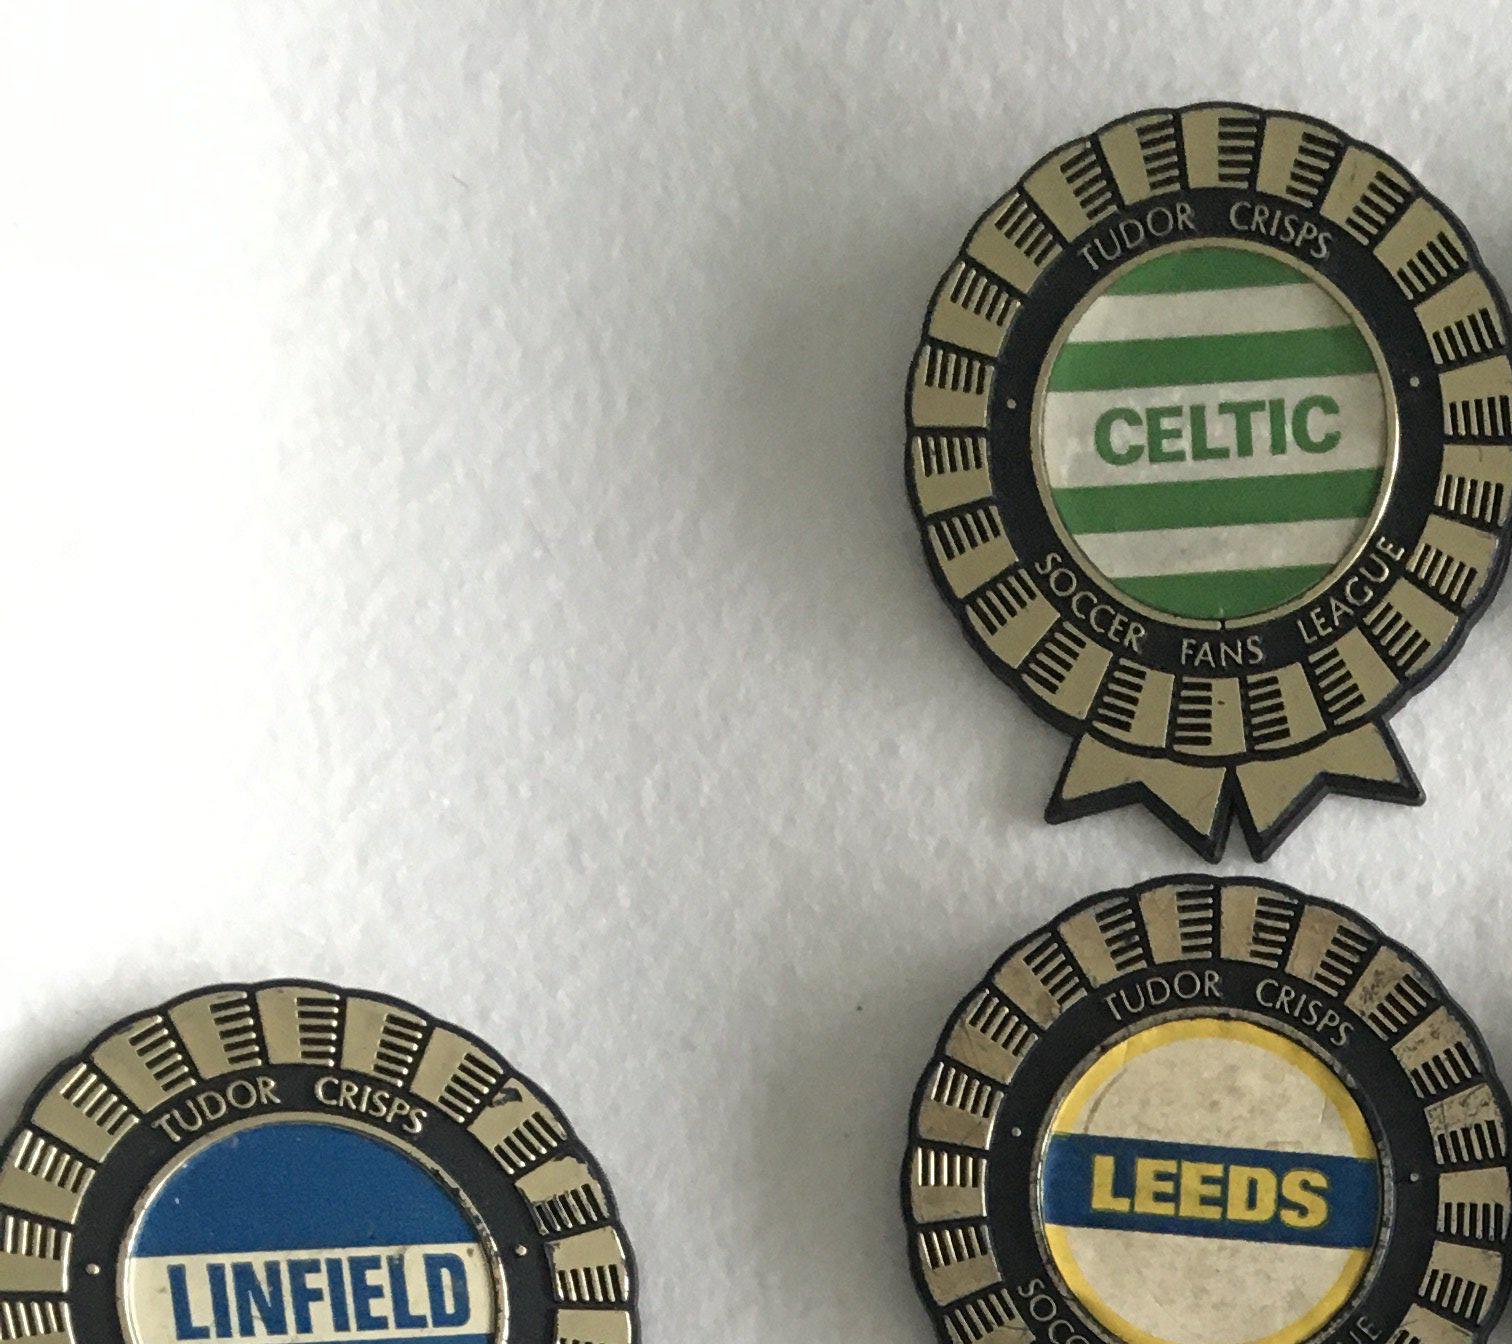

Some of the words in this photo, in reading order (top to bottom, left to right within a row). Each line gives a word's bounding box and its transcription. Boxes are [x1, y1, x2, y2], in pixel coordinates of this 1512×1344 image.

[1077, 202, 1197, 272] TUDOR
[1229, 202, 1334, 261] CRISPS
[1094, 394, 1342, 466] CELTIC
[1035, 552, 1146, 653] SOCCER
[1180, 636, 1264, 667] FANS
[1298, 536, 1405, 644] LEAGUE
[1103, 970, 1222, 1021] TUDOR
[1255, 978, 1354, 1047] CRISPS
[151, 1076, 282, 1143] TUDOR
[314, 1076, 428, 1133] CRISPS
[1091, 1154, 1332, 1228] LEEDS
[167, 1253, 472, 1341] LINFIELD
